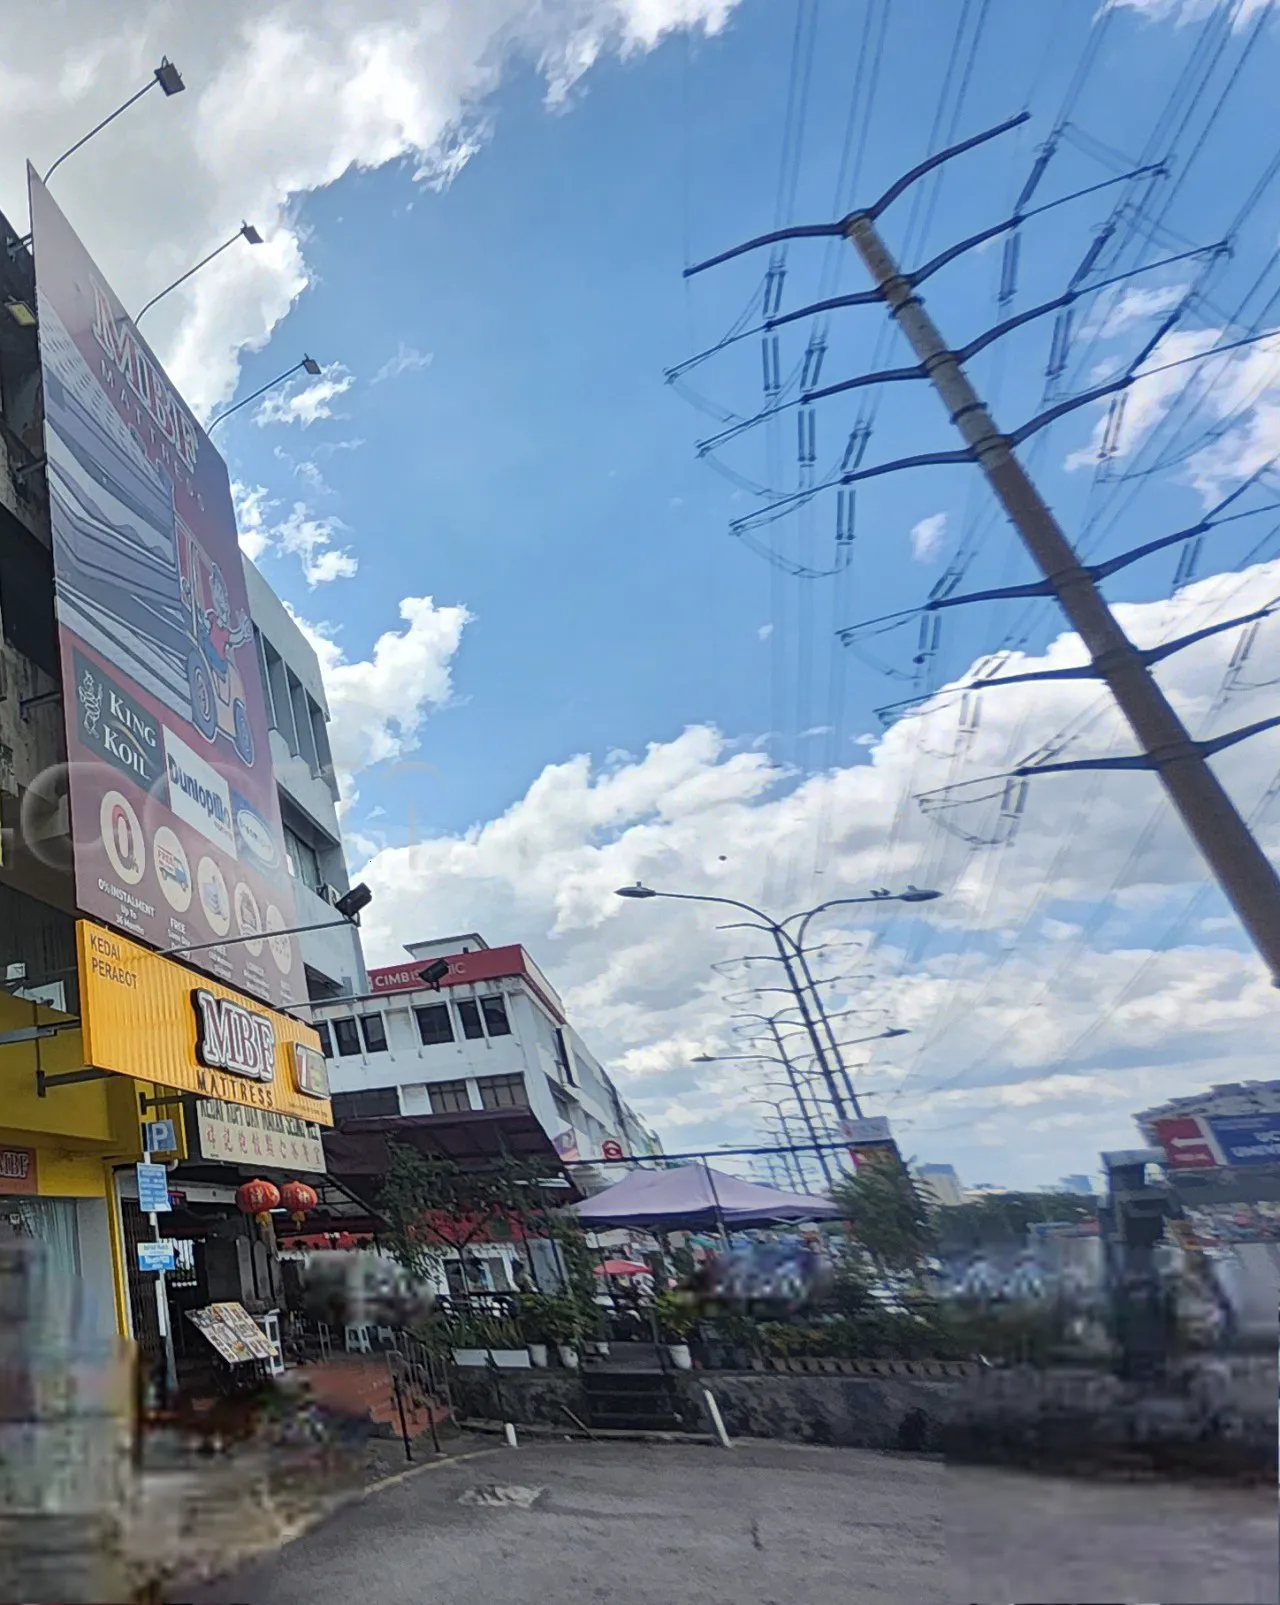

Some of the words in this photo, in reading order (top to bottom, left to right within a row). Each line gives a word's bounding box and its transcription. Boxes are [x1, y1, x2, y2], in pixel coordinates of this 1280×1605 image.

[109, 690, 157, 747] KING
[103, 723, 152, 782] KOIL
[166, 752, 232, 831] Dunlopillo
[111, 883, 156, 918] INSTALMENT
[90, 933, 121, 962] KEDAI
[91, 956, 137, 990] PERABOT
[375, 971, 410, 987] CIMB
[198, 990, 274, 1081] MBF
[196, 1069, 274, 1106] MATTRESS
[151, 1123, 169, 1150] P
